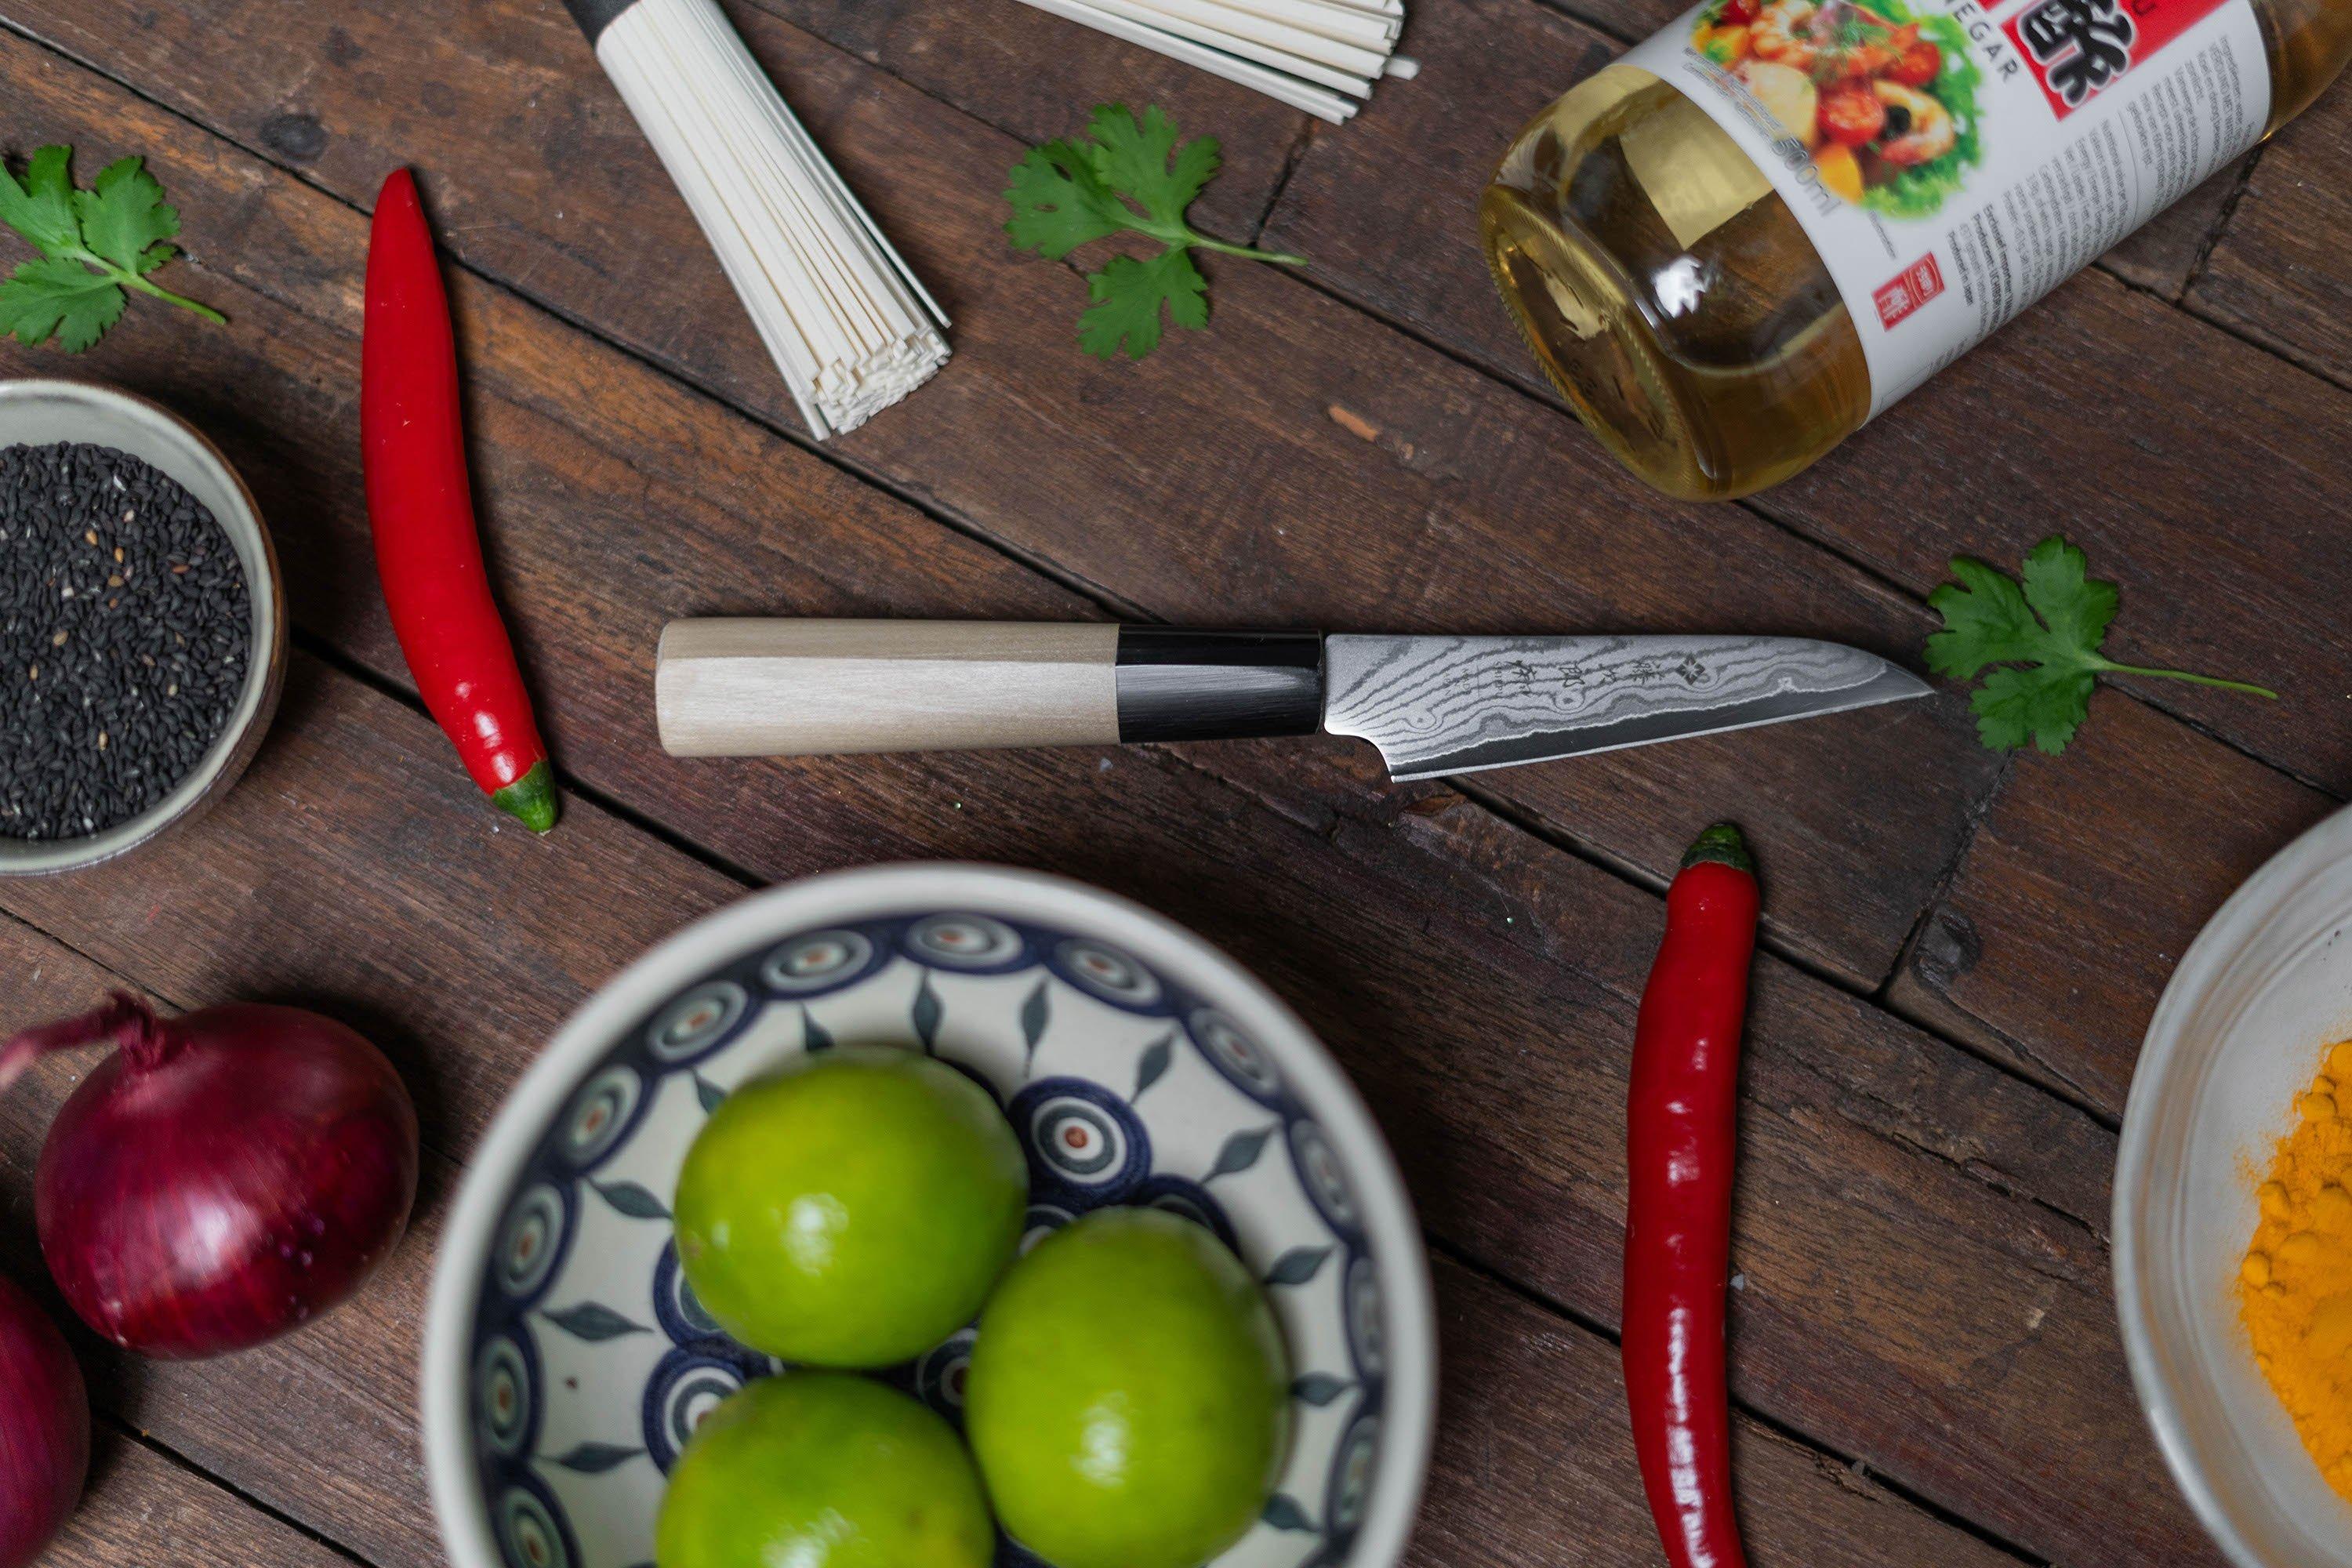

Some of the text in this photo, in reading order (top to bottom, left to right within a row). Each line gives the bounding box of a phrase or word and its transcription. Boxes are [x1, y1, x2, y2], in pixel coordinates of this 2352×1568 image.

[1945, 0, 2020, 82] EGAR
[1769, 134, 1842, 218] 500ml
[1969, 212, 1996, 270] Producent:
[1983, 202, 2005, 251] Exclusief
[1944, 230, 1968, 274] Produced
[1962, 281, 1975, 308] Japan
